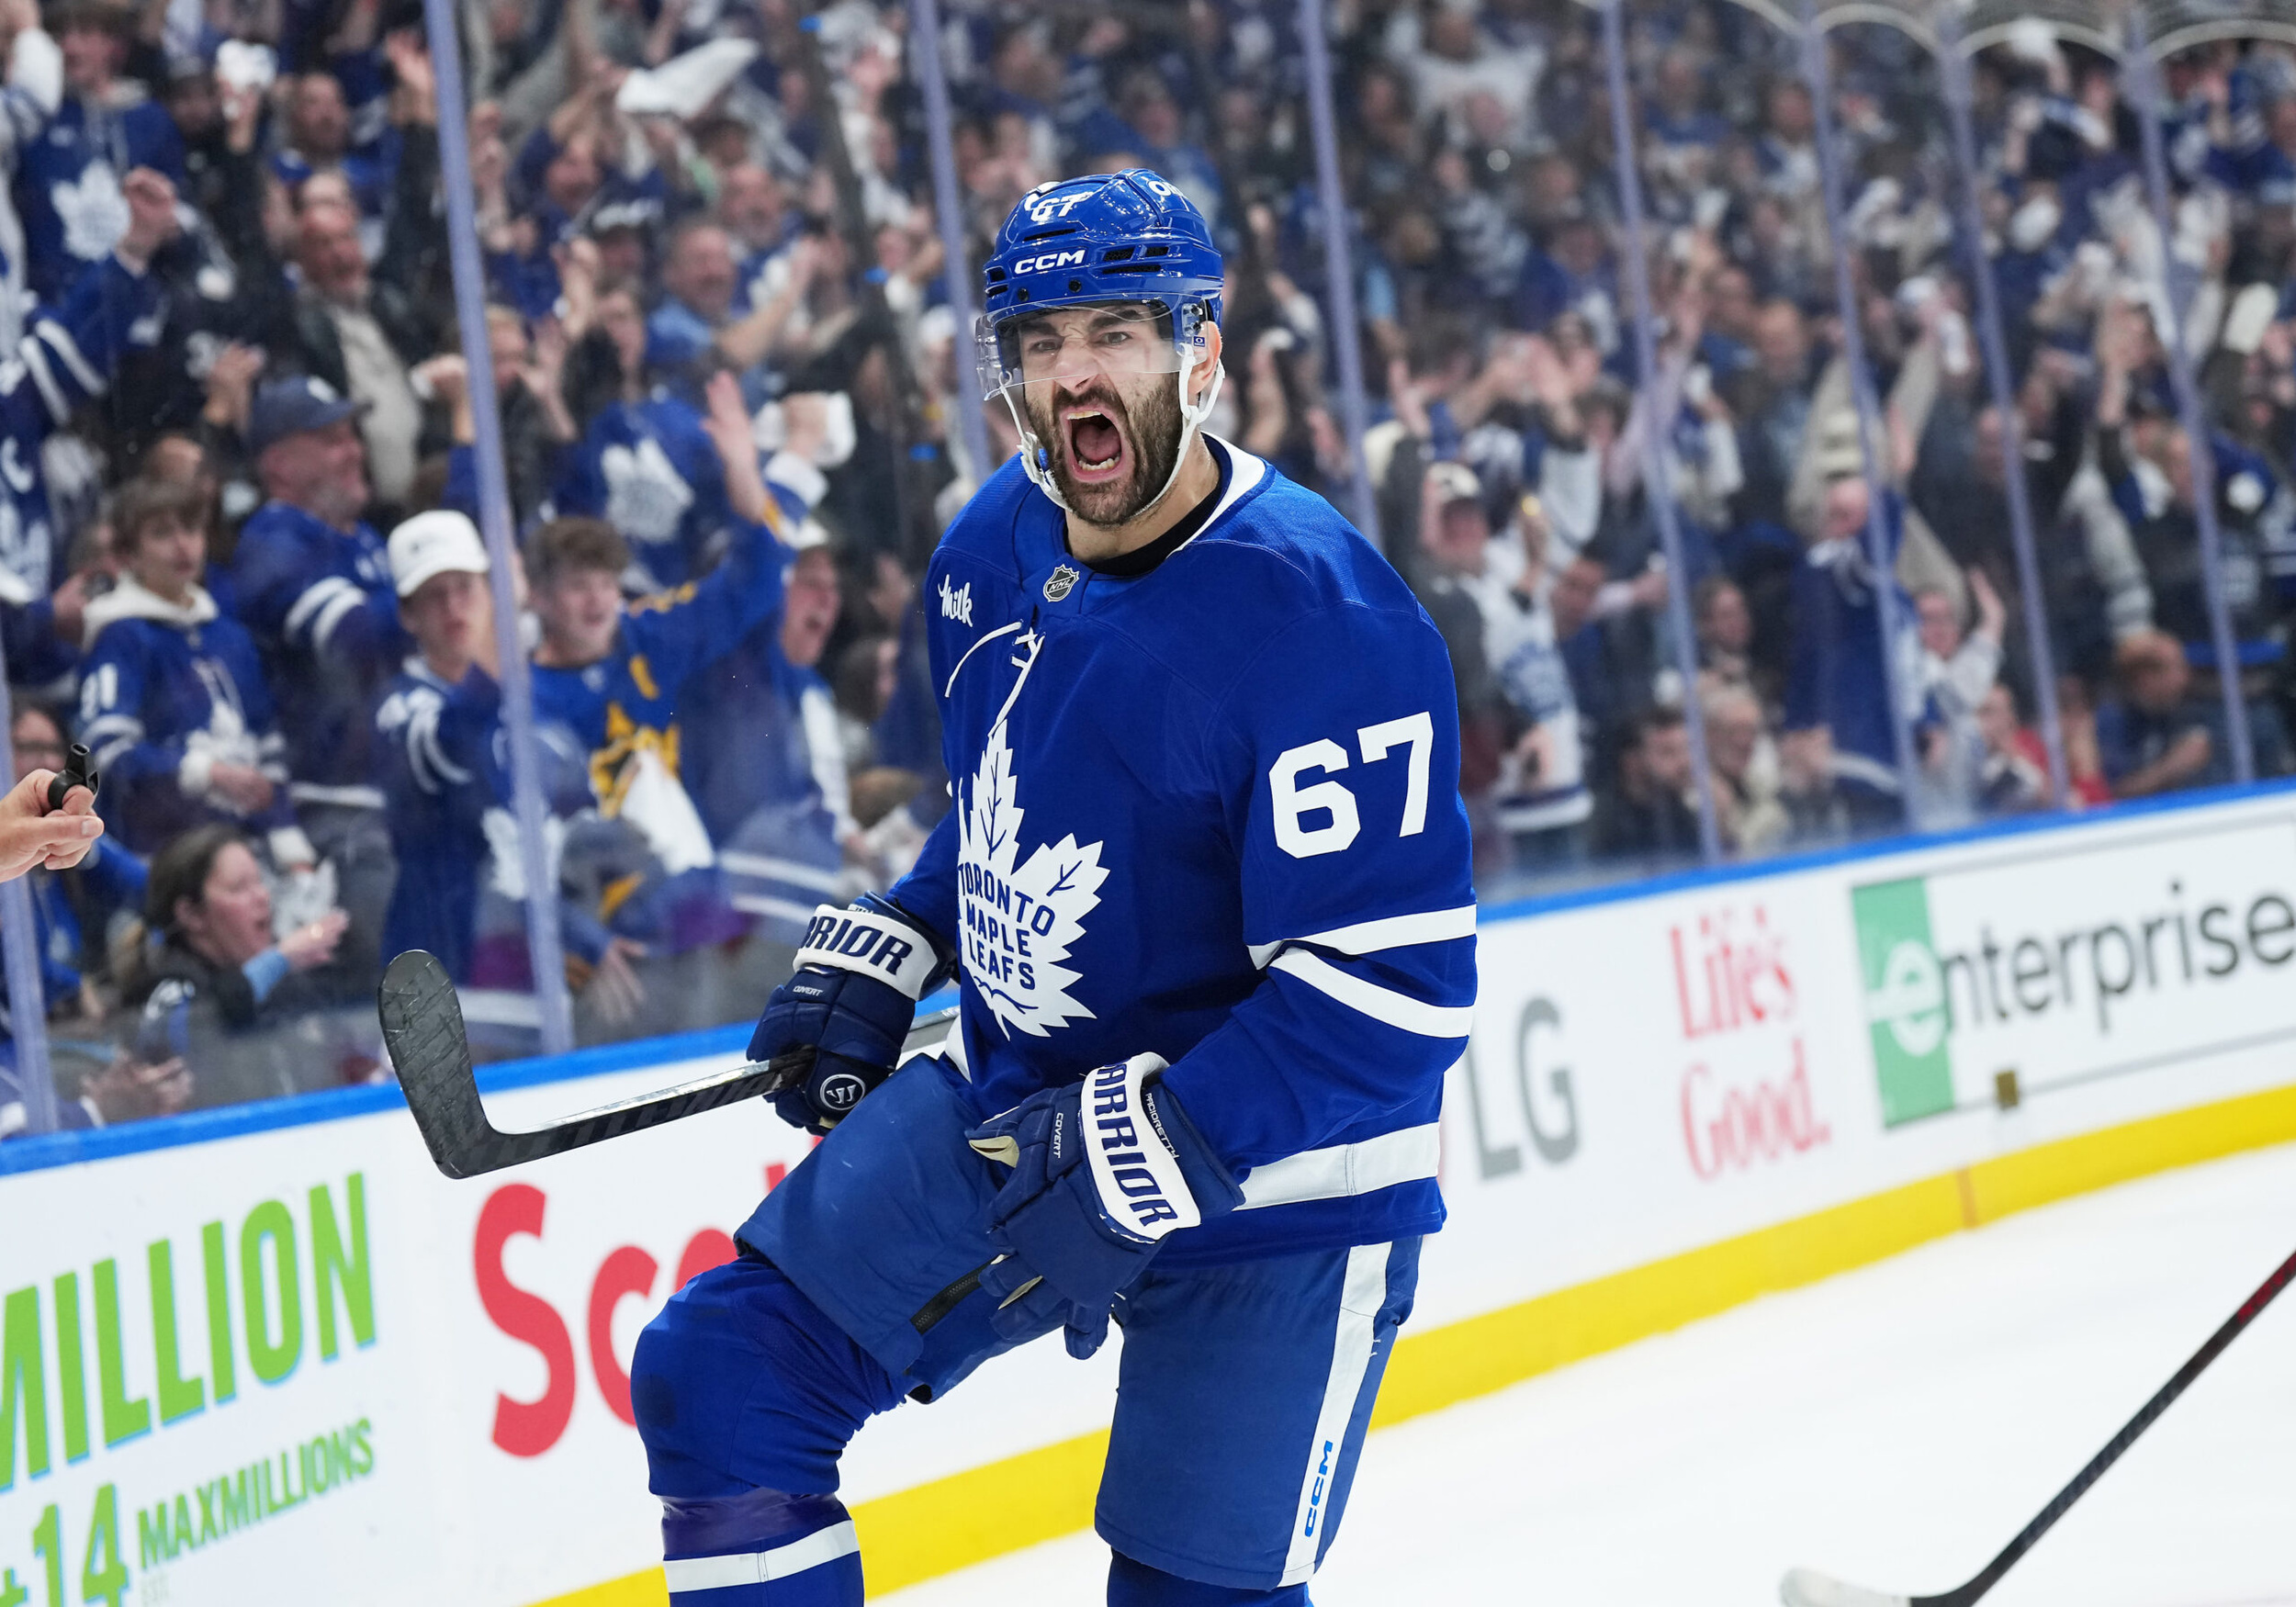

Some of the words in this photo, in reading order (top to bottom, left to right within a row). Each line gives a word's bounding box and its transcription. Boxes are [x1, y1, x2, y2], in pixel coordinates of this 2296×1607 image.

[1030, 192, 1094, 222] 67
[1014, 250, 1086, 275] CCM
[938, 574, 973, 628] Milk
[1049, 579, 1071, 592] NHL
[1268, 712, 1434, 859] 67
[958, 861, 1055, 937] TORONTO
[966, 898, 1031, 958] MAPLE
[968, 932, 1035, 990] LEAFS
[1870, 879, 2296, 1056] enterprise
[1463, 997, 1580, 1179] LG
[1052, 1112, 1064, 1159] COVERT
[1094, 1063, 1178, 1227] ARRIOR
[138, 1417, 375, 1572] MAXMILLIONS
[1304, 1440, 1334, 1538] CCM
